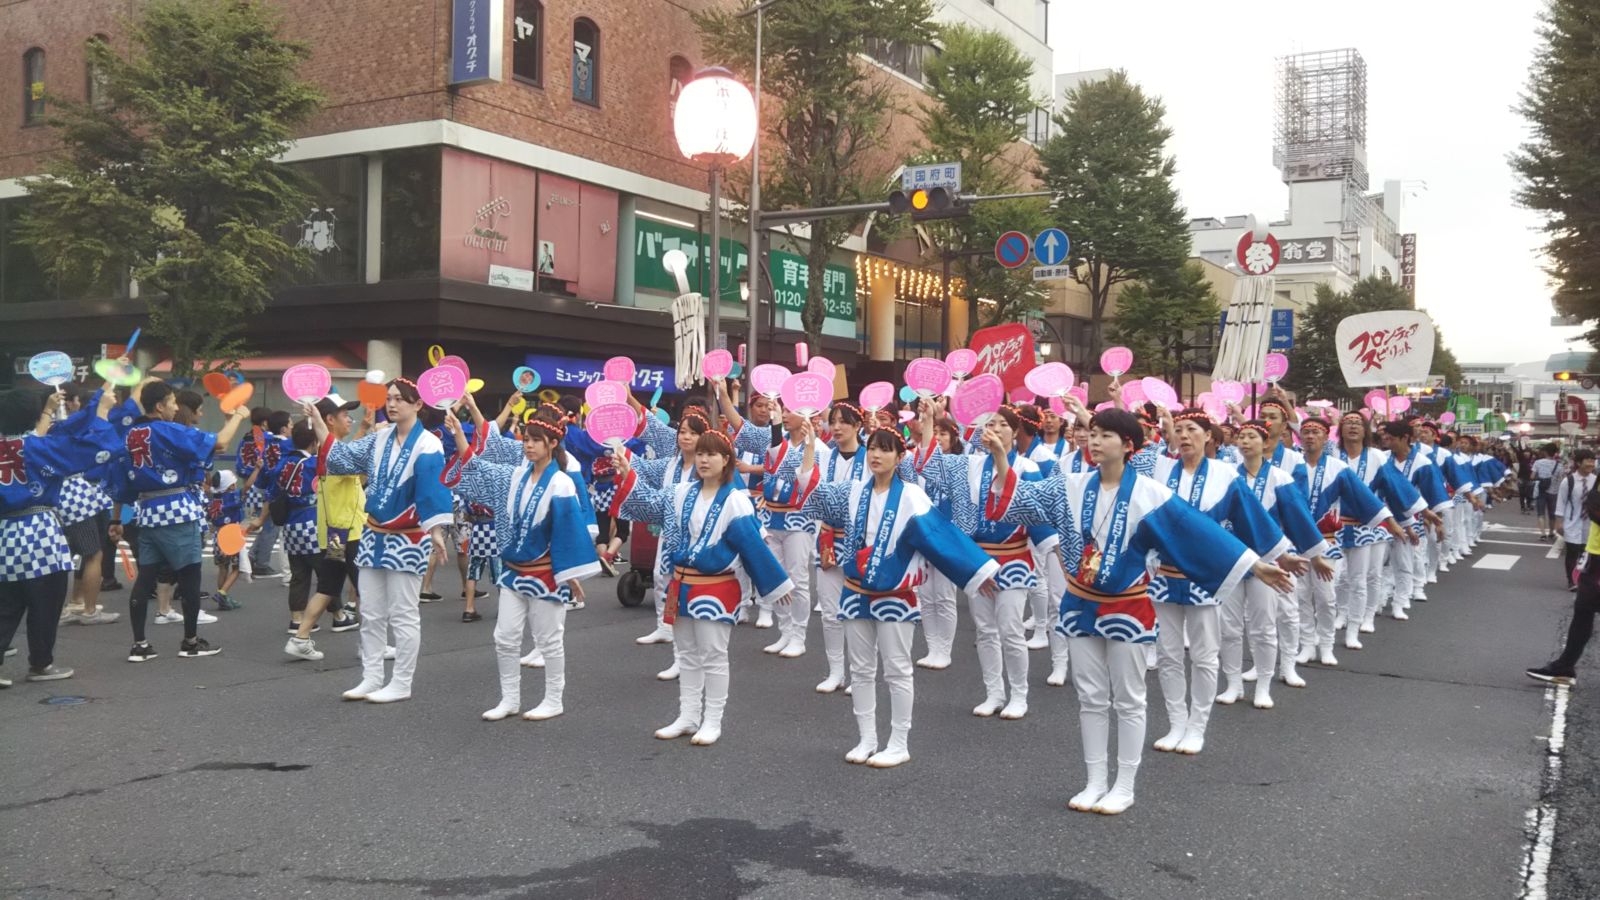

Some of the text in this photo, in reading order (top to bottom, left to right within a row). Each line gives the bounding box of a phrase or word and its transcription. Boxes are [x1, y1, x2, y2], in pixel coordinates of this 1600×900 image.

[915, 167, 955, 182] 国府町
[464, 235, 508, 253] OGUCHI
